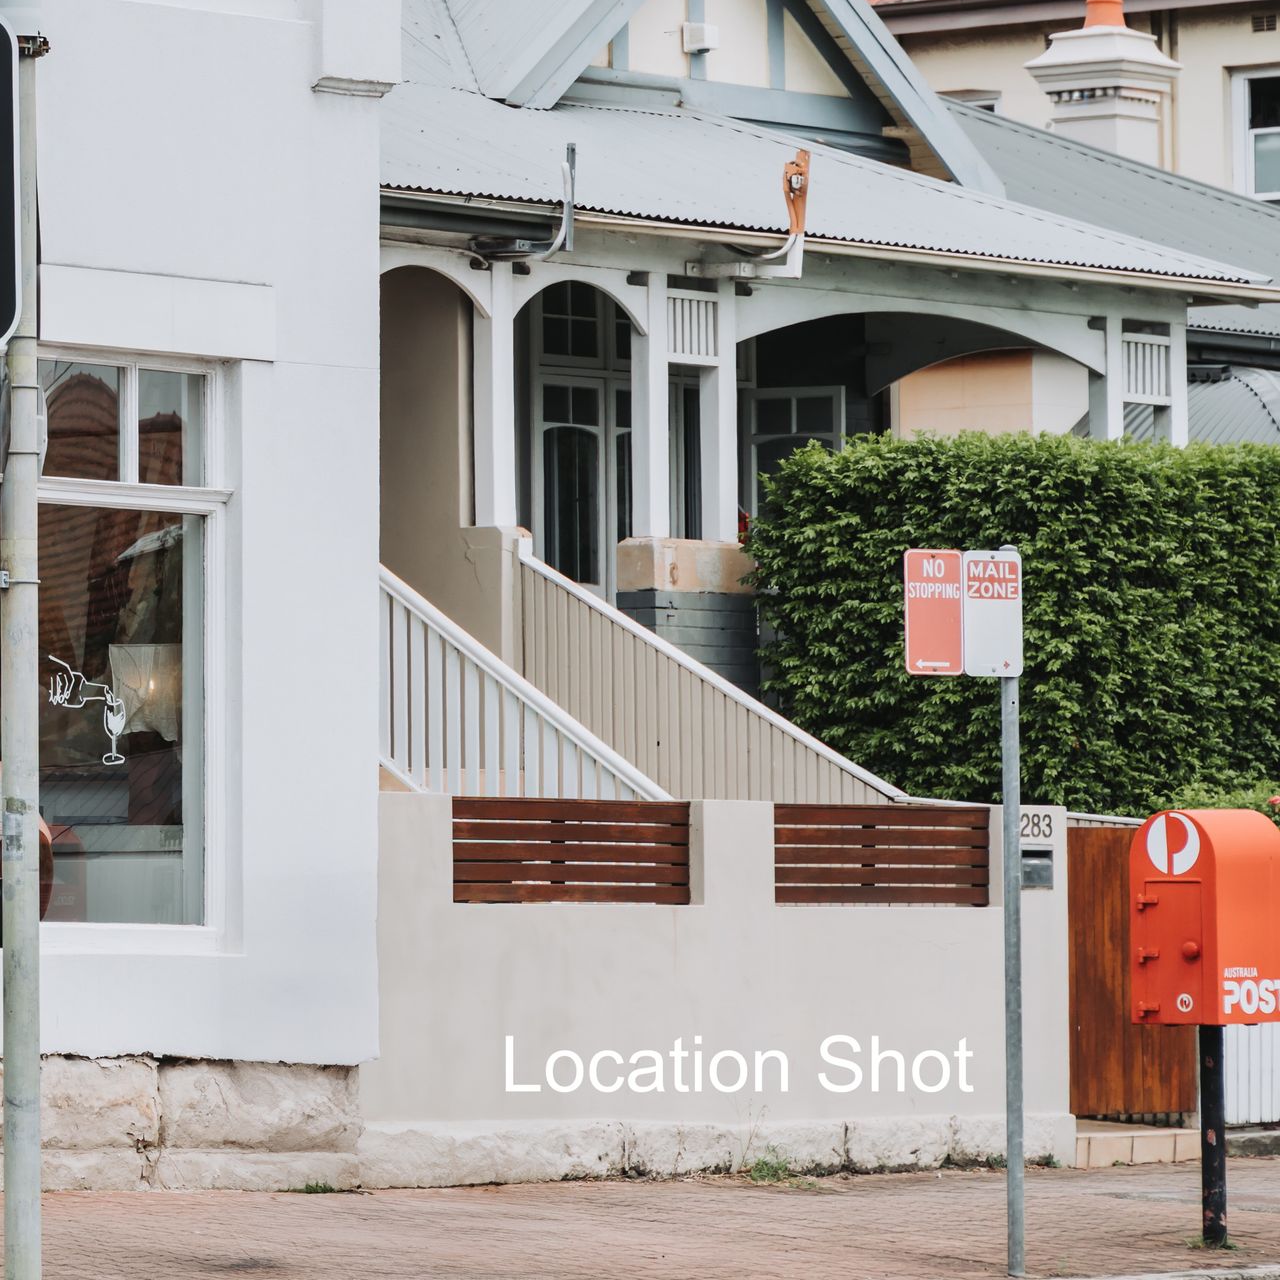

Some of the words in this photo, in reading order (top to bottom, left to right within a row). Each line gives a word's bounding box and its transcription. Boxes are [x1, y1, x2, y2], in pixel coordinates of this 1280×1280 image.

[923, 559, 945, 578] NO
[969, 562, 1017, 579] MAIL
[908, 582, 960, 599] STOPPING
[968, 582, 1018, 598] ZONE
[1020, 813, 1053, 838] 283
[1224, 967, 1258, 978] AUSTRALIA
